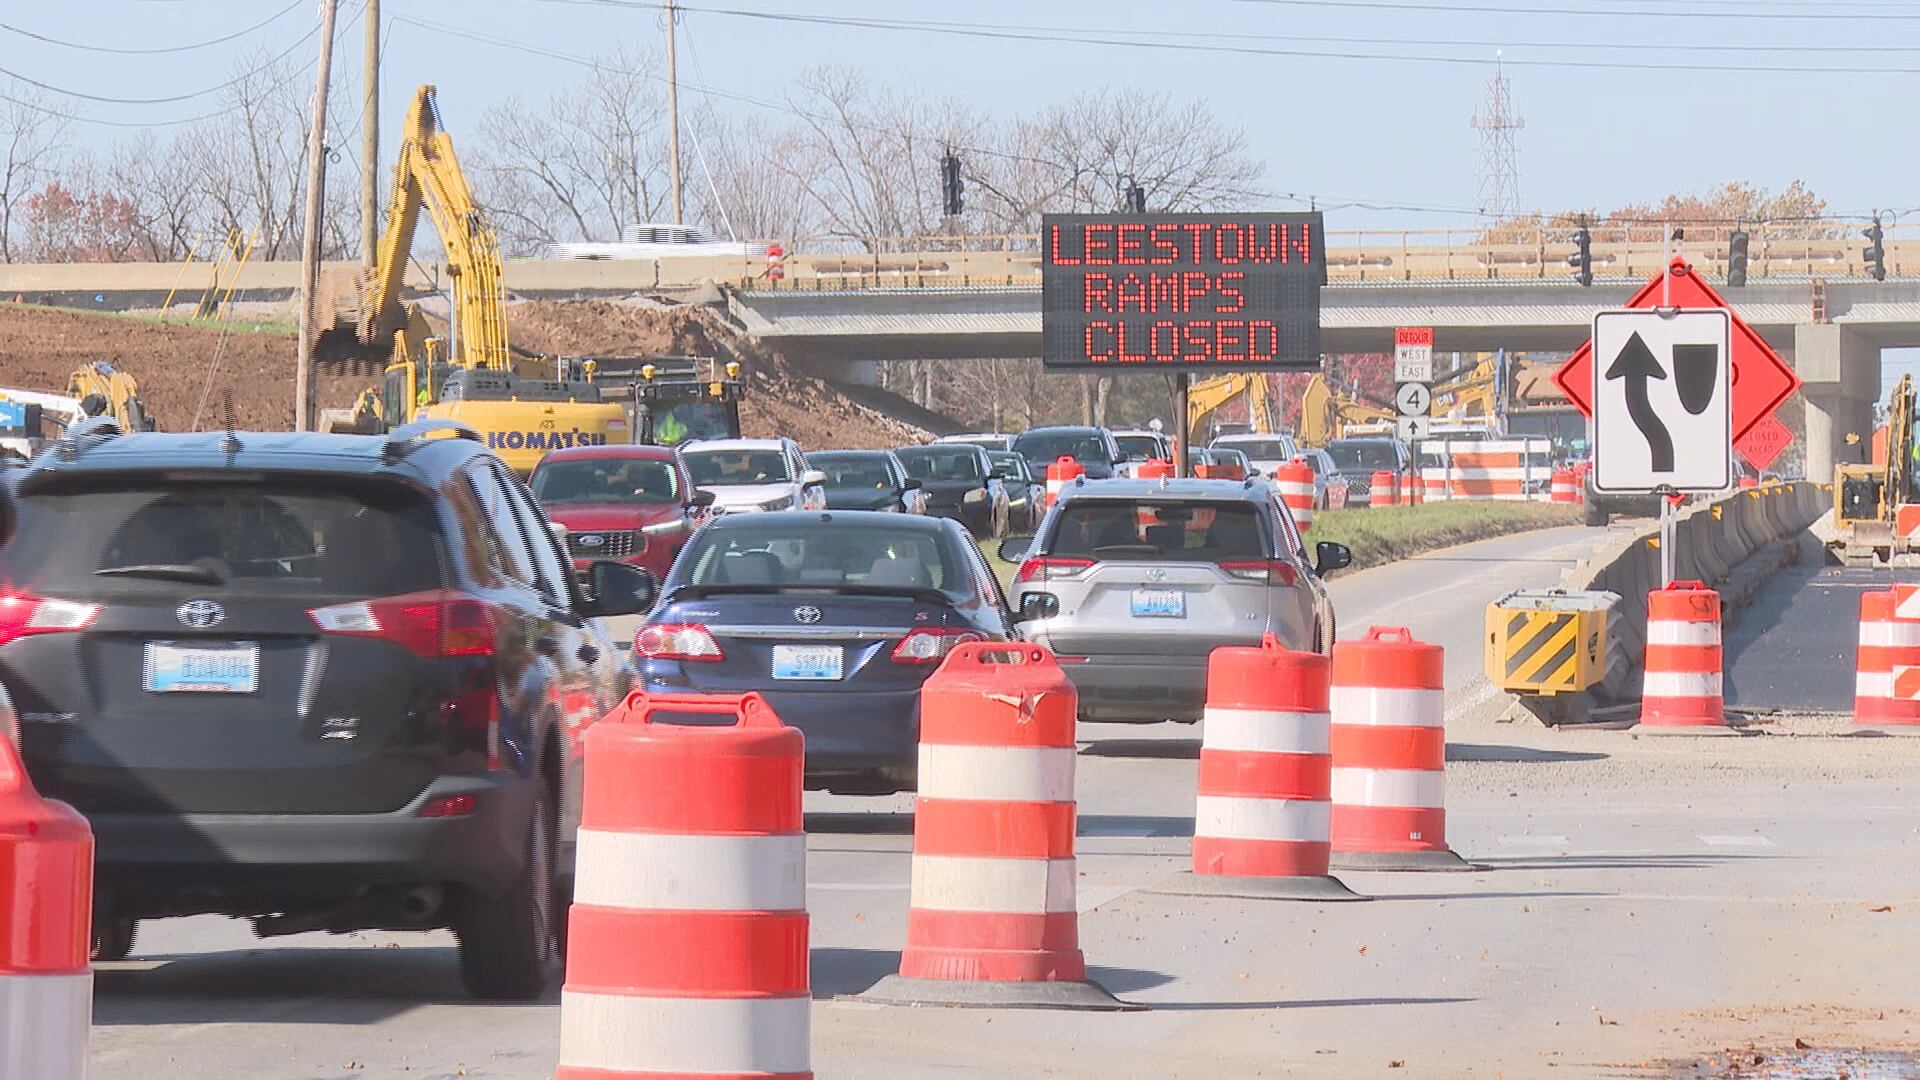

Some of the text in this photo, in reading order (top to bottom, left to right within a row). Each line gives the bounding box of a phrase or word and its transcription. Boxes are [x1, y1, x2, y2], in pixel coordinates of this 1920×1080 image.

[1051, 223, 1310, 265] LEESTOWN
[1084, 272, 1245, 313] RAMPS
[1084, 320, 1278, 362] CLOSED
[1400, 331, 1429, 343] DETOUR
[1400, 349, 1425, 360] WEST
[1401, 365, 1425, 377] EAST
[1407, 389, 1420, 408] 4
[487, 427, 607, 449] KOMATSU
